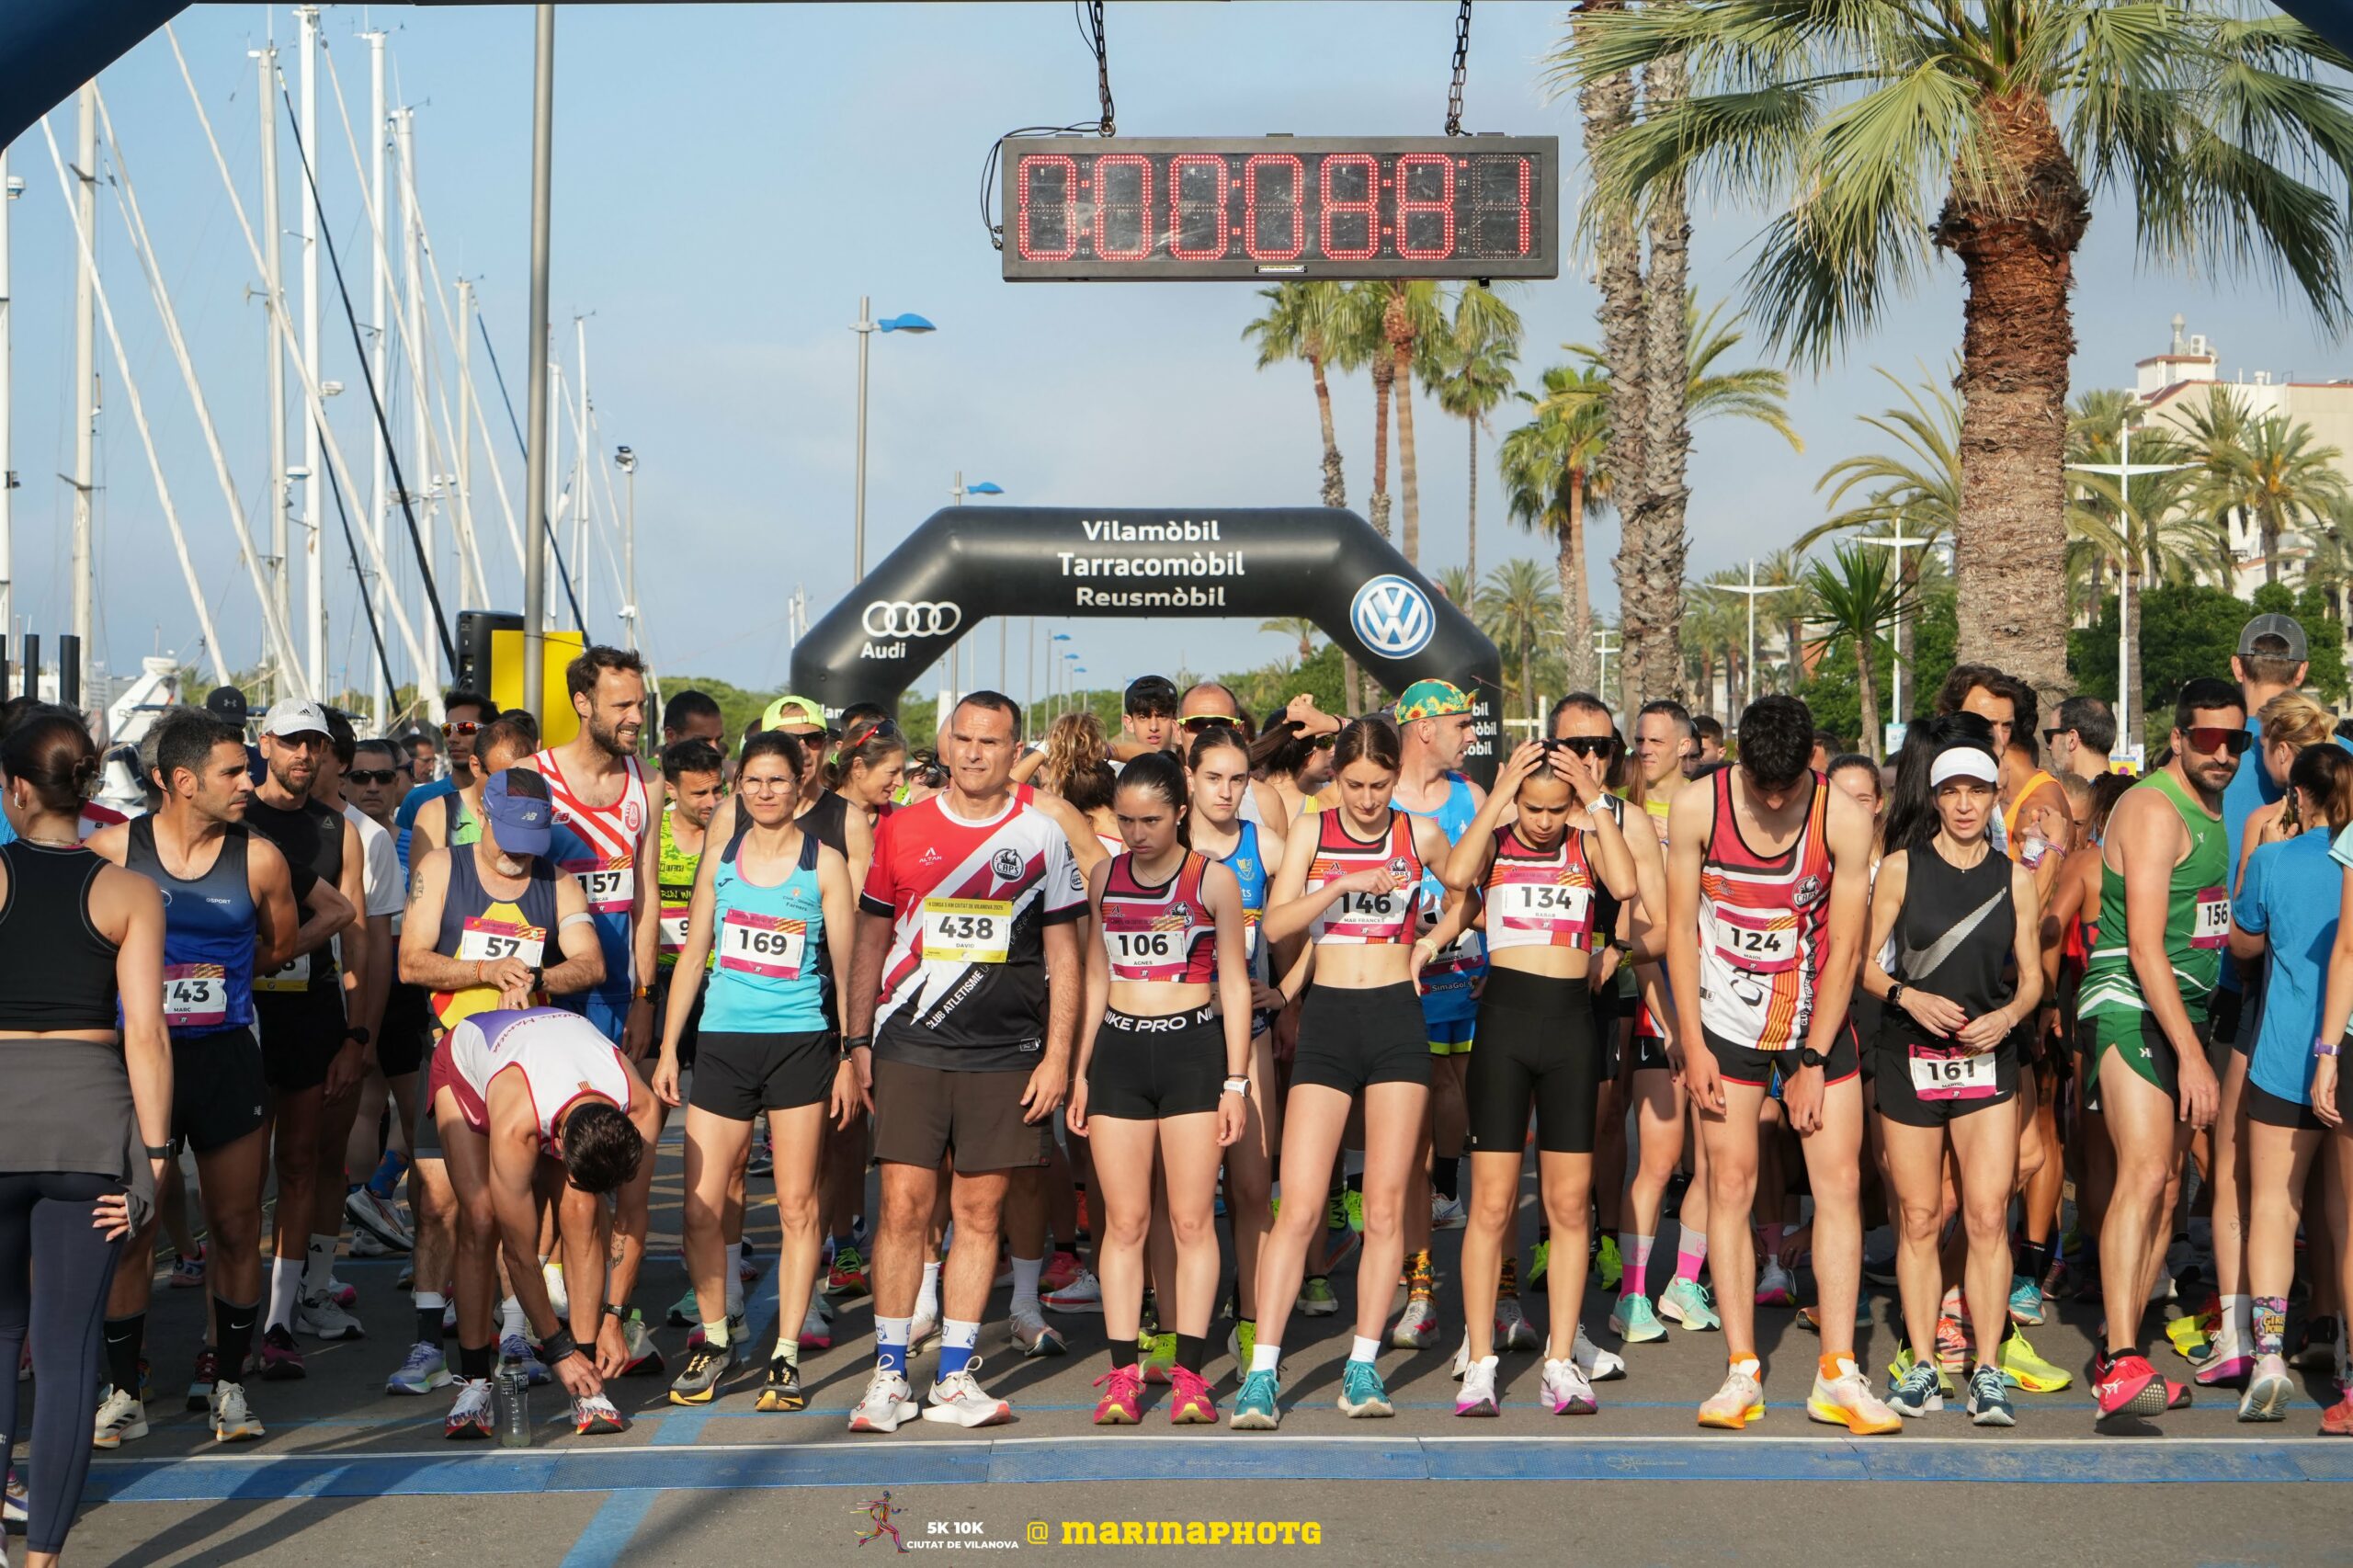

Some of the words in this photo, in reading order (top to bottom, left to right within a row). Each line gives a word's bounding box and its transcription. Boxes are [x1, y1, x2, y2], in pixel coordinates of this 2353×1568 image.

[1082, 520, 1221, 541] Vilamòbil
[1057, 551, 1245, 576] Tarracomòbil
[1076, 586, 1226, 607] Reusmòbil
[860, 642, 906, 659] Audi
[577, 872, 620, 894] 157
[1341, 892, 1391, 915] 146
[1521, 886, 1572, 910] 134
[2207, 903, 2228, 926] 156
[938, 915, 994, 939] 438
[485, 936, 521, 958] 57
[740, 928, 788, 956] 169
[1118, 934, 1169, 957] 106
[1731, 926, 1781, 952] 124
[926, 1010, 946, 1030] CLUB
[946, 970, 984, 1014] ATLETISME
[1134, 1016, 1187, 1032] PRO
[1927, 1059, 1975, 1081] 161
